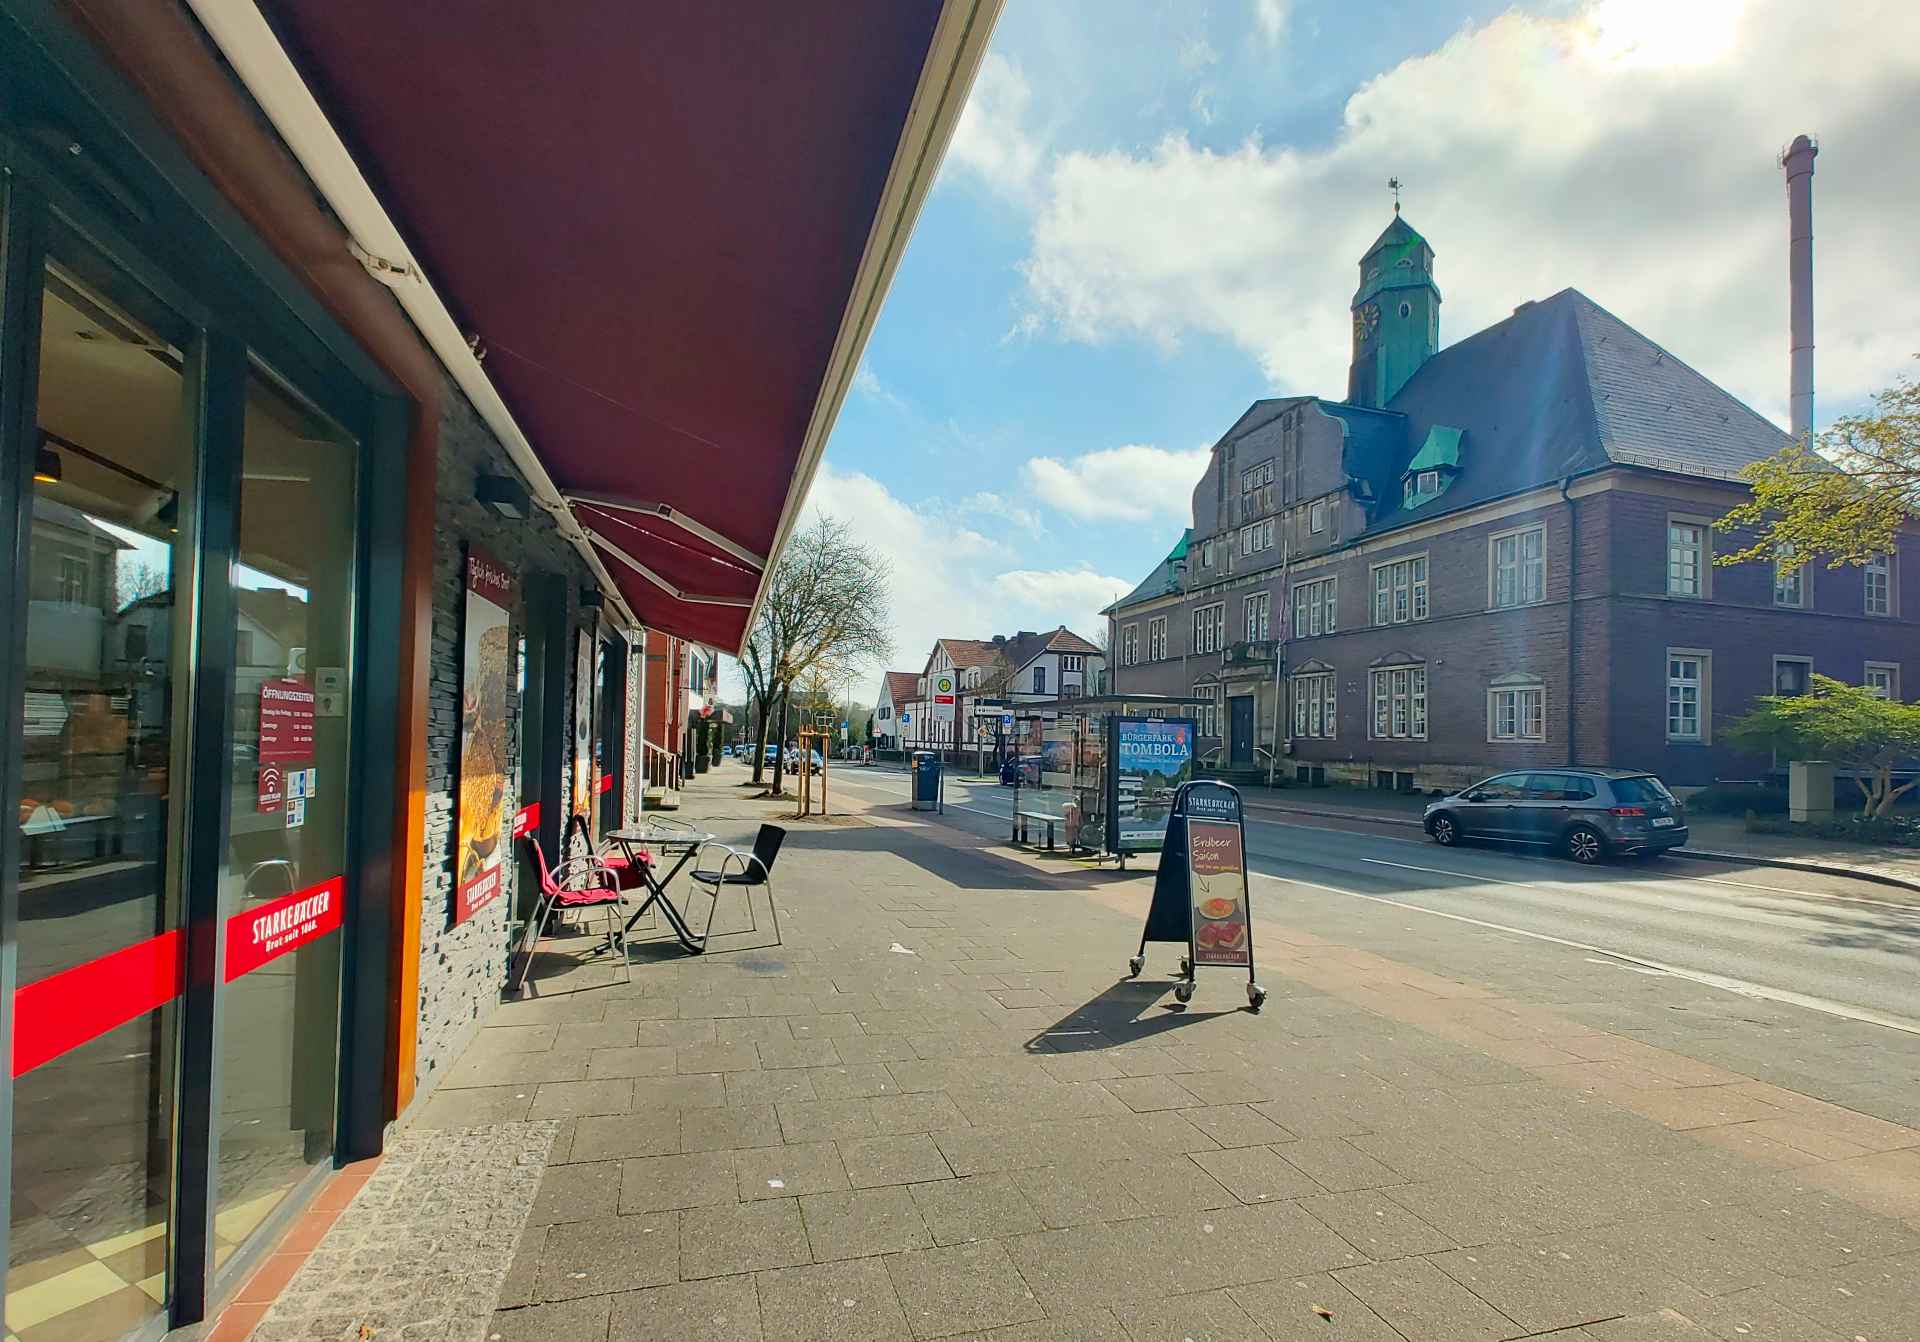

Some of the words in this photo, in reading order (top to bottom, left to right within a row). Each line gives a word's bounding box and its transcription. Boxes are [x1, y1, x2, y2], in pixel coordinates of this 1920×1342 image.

[1120, 743, 1189, 756] TOMBOLA
[252, 890, 330, 945] STARKEBÄCKER
[265, 936, 283, 953] Brot
[284, 928, 299, 944] seit
